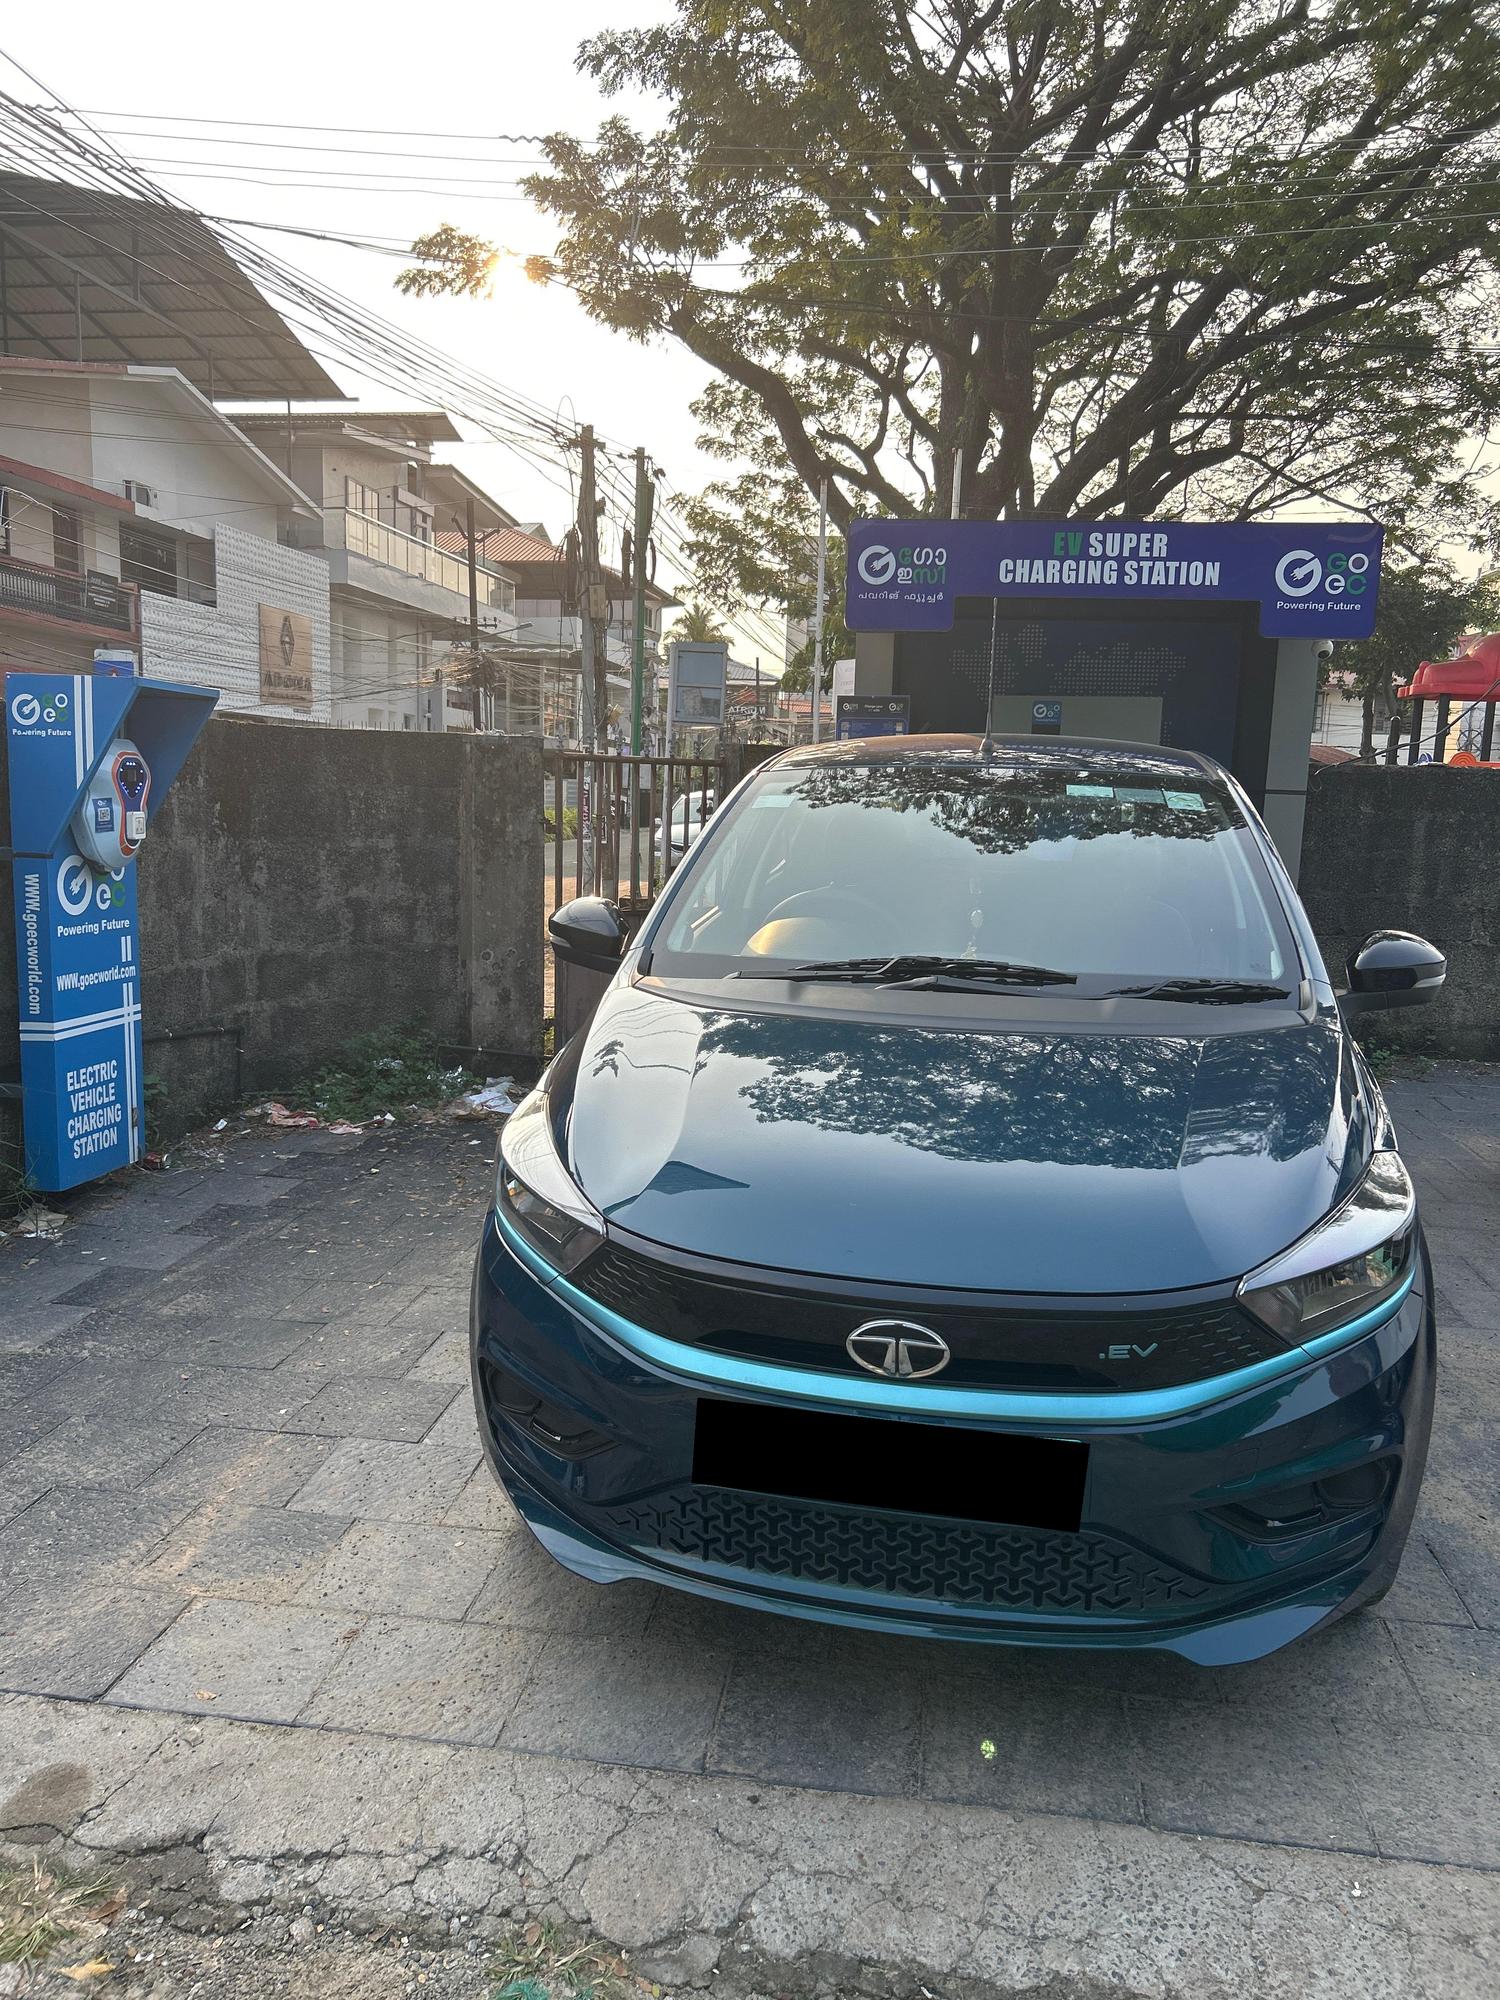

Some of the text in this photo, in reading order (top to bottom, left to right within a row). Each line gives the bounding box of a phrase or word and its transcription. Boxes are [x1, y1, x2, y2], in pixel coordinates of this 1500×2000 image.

[1053, 532, 1168, 557] EV SUPER
[999, 559, 1220, 586] CHARGING STATION
[1276, 601, 1361, 612] Powering Future
[12, 729, 46, 737] Powering
[57, 919, 130, 938] Powering Future
[66, 1059, 118, 1092] ELECTRIC
[70, 1082, 116, 1113] VEHICLE
[67, 1103, 122, 1140] CHARGING
[73, 1126, 118, 1160] STATION
